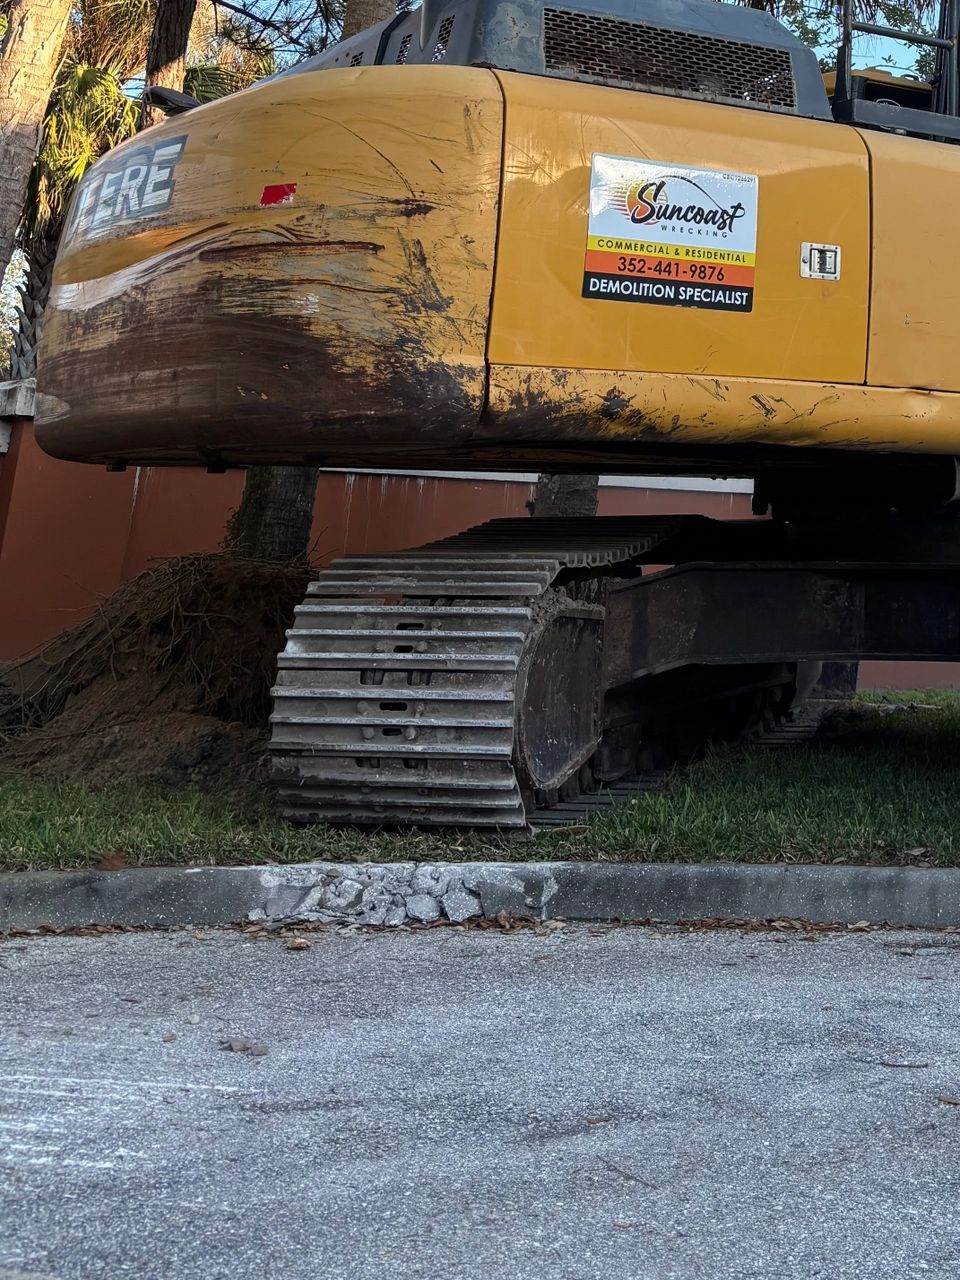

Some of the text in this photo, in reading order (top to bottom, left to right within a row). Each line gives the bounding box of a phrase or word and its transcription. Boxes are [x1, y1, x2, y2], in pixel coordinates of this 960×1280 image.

[631, 180, 746, 232] Suncoast
[660, 224, 728, 238] WRECKING
[597, 239, 746, 263] COMMERCIAL & RESIDENTIAL
[617, 256, 725, 282] 352-441-9876
[589, 278, 749, 306] DEMOLITION SPECIALIST
